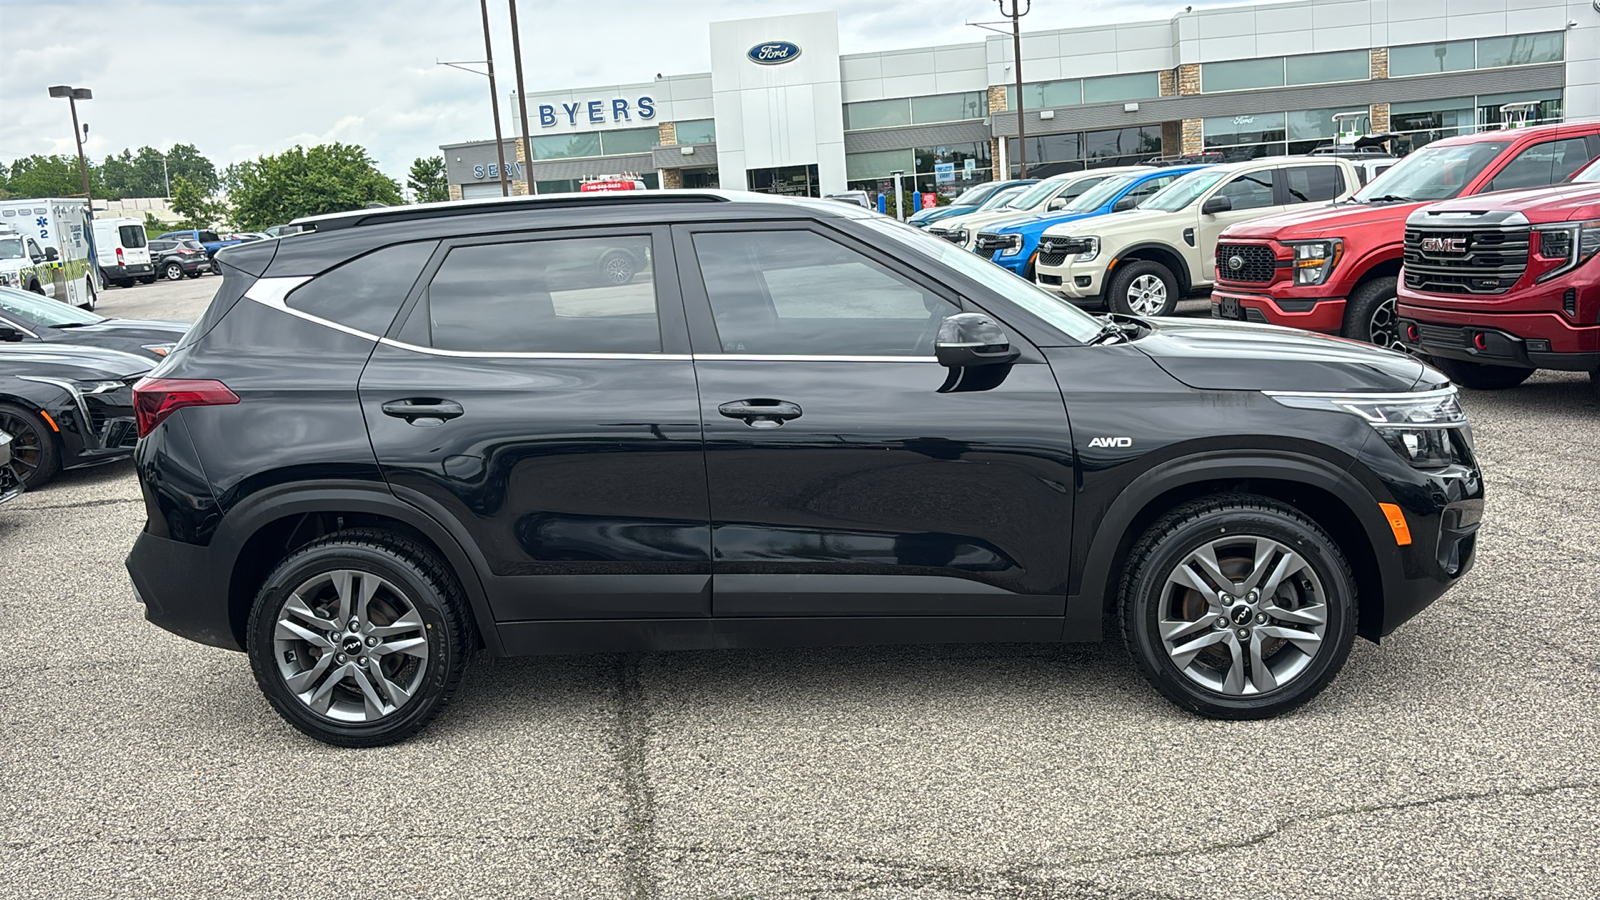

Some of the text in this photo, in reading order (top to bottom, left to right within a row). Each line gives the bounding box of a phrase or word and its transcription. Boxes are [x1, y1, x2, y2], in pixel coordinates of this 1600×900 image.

[758, 44, 789, 59] Ford
[538, 96, 656, 127] BYERS
[1233, 115, 1254, 125] Ford
[40, 229, 48, 239] 2
[1422, 238, 1466, 252] GMC
[1087, 436, 1132, 448] AWD
